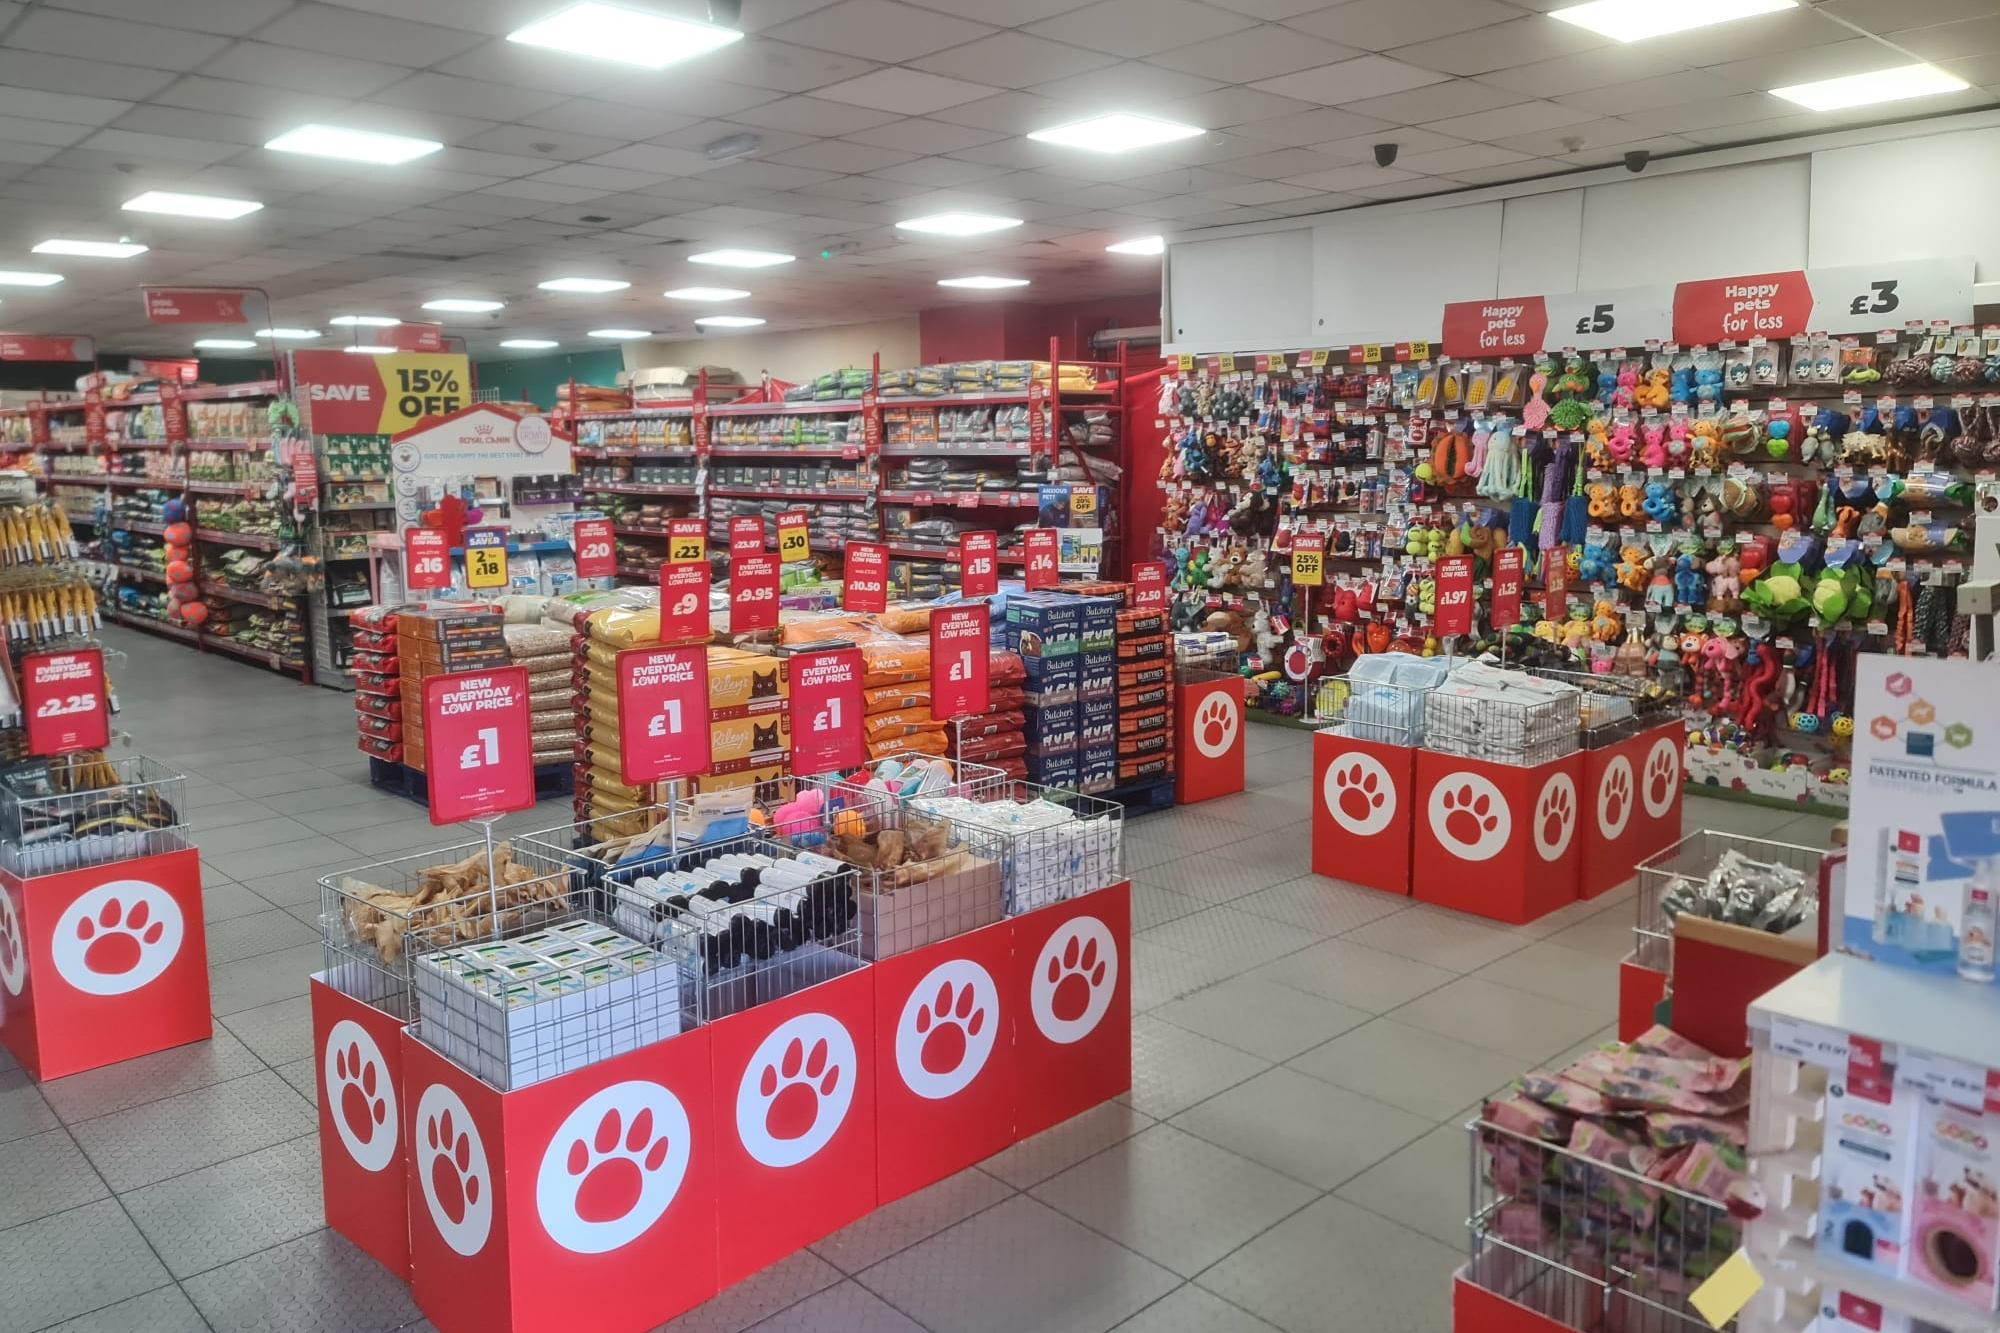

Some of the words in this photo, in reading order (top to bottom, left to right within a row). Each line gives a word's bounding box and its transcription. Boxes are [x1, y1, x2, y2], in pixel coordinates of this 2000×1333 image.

[1725, 284, 1779, 298] Happy
[1850, 280, 1899, 315] £3
[1482, 305, 1523, 318] Happy
[1733, 299, 1771, 314] pets
[1488, 318, 1516, 331] pets
[1576, 304, 1614, 334] £5
[1722, 313, 1748, 333] for
[1754, 314, 1783, 330] less
[1480, 331, 1499, 348] for
[1503, 331, 1525, 346] less
[397, 369, 459, 394] 15%
[311, 384, 370, 401] SAVE
[399, 396, 460, 418] OFF
[780, 515, 804, 525] SAVE
[674, 524, 702, 533] SAVE
[469, 537, 500, 546] SAVER
[783, 536, 805, 549] £30
[476, 551, 486, 562] 2
[581, 543, 610, 558] £20
[674, 546, 700, 559] £23
[414, 557, 443, 573] £16
[1296, 555, 1318, 563] 25%
[476, 562, 499, 575] £18
[754, 568, 772, 576] PRICE
[968, 557, 991, 575] £15
[1296, 564, 1318, 573] OFF
[669, 571, 702, 580] EVERYDAY
[684, 577, 703, 585] PRICE
[849, 580, 880, 592] £10.50
[736, 587, 773, 602] £9.95
[1136, 590, 1161, 602] £2.50
[1441, 590, 1467, 605] £1.97
[672, 593, 698, 615] £9
[1086, 605, 1113, 616] Butcher's
[951, 613, 969, 621] NEW
[1047, 610, 1075, 621] Butcher's
[941, 620, 980, 630] EVERYDAY
[940, 630, 958, 639] LOW
[959, 628, 980, 637] PRICE
[50, 656, 75, 665] NEW
[648, 653, 676, 665] NEW
[815, 656, 838, 667] NEW
[1046, 659, 1074, 670] Butcher's
[1084, 654, 1111, 665] Butcher's
[36, 662, 91, 675] EVERYDAY
[633, 662, 692, 677] EVERYDAY
[802, 664, 850, 677] EVERYDAY
[949, 651, 972, 681] £1
[35, 674, 59, 683] LOW
[62, 669, 92, 680] PRICE
[632, 673, 659, 687] LOW
[661, 671, 694, 683] PRICE
[801, 674, 823, 687] LOW
[826, 672, 852, 683] PRICE
[460, 678, 492, 690] NEW
[442, 686, 511, 704] EVERYDAY
[37, 694, 97, 718] £2.25
[441, 701, 472, 715] LOW
[475, 696, 513, 711] PRICE
[1085, 702, 1112, 714] Butcher's
[648, 699, 682, 737] £1
[813, 697, 841, 731] £1
[1044, 708, 1074, 720] Butcher's
[459, 727, 500, 770] £1
[1086, 749, 1112, 761] Butcher's
[1046, 756, 1074, 769] Butcher's
[1869, 765, 1931, 784] PATENTED
[1934, 774, 1998, 792] FORMULA
